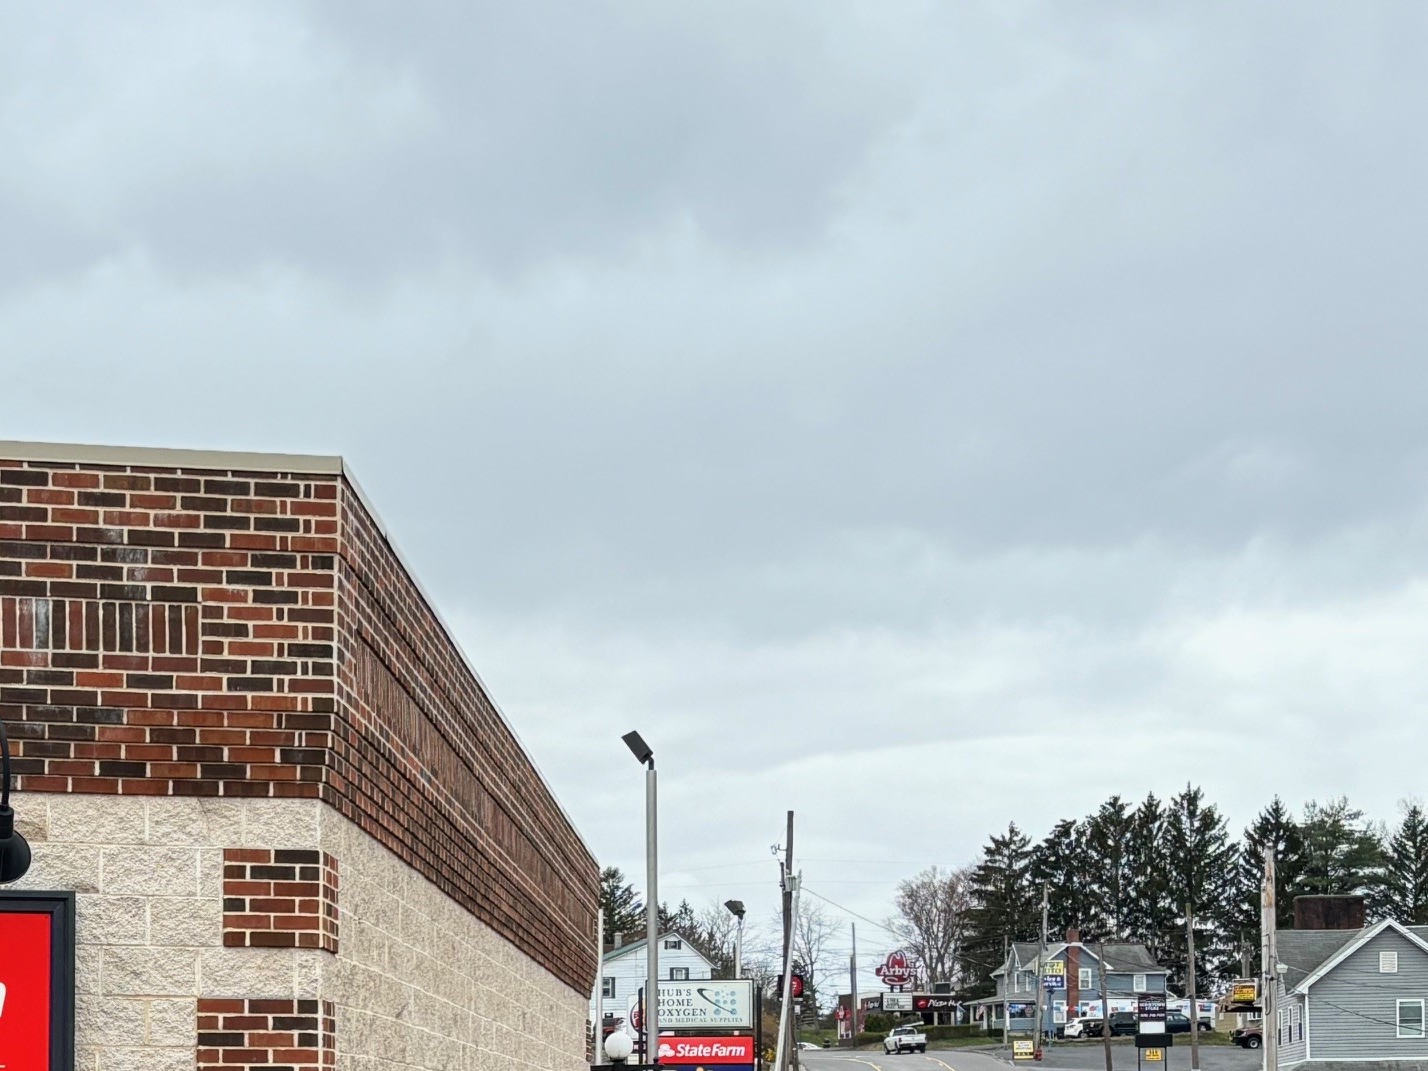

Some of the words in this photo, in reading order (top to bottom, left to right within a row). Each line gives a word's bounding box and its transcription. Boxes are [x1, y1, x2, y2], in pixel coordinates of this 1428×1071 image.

[658, 988, 692, 997] HUB'S
[658, 998, 693, 1007] HOME
[658, 1008, 707, 1017] OXYGEN
